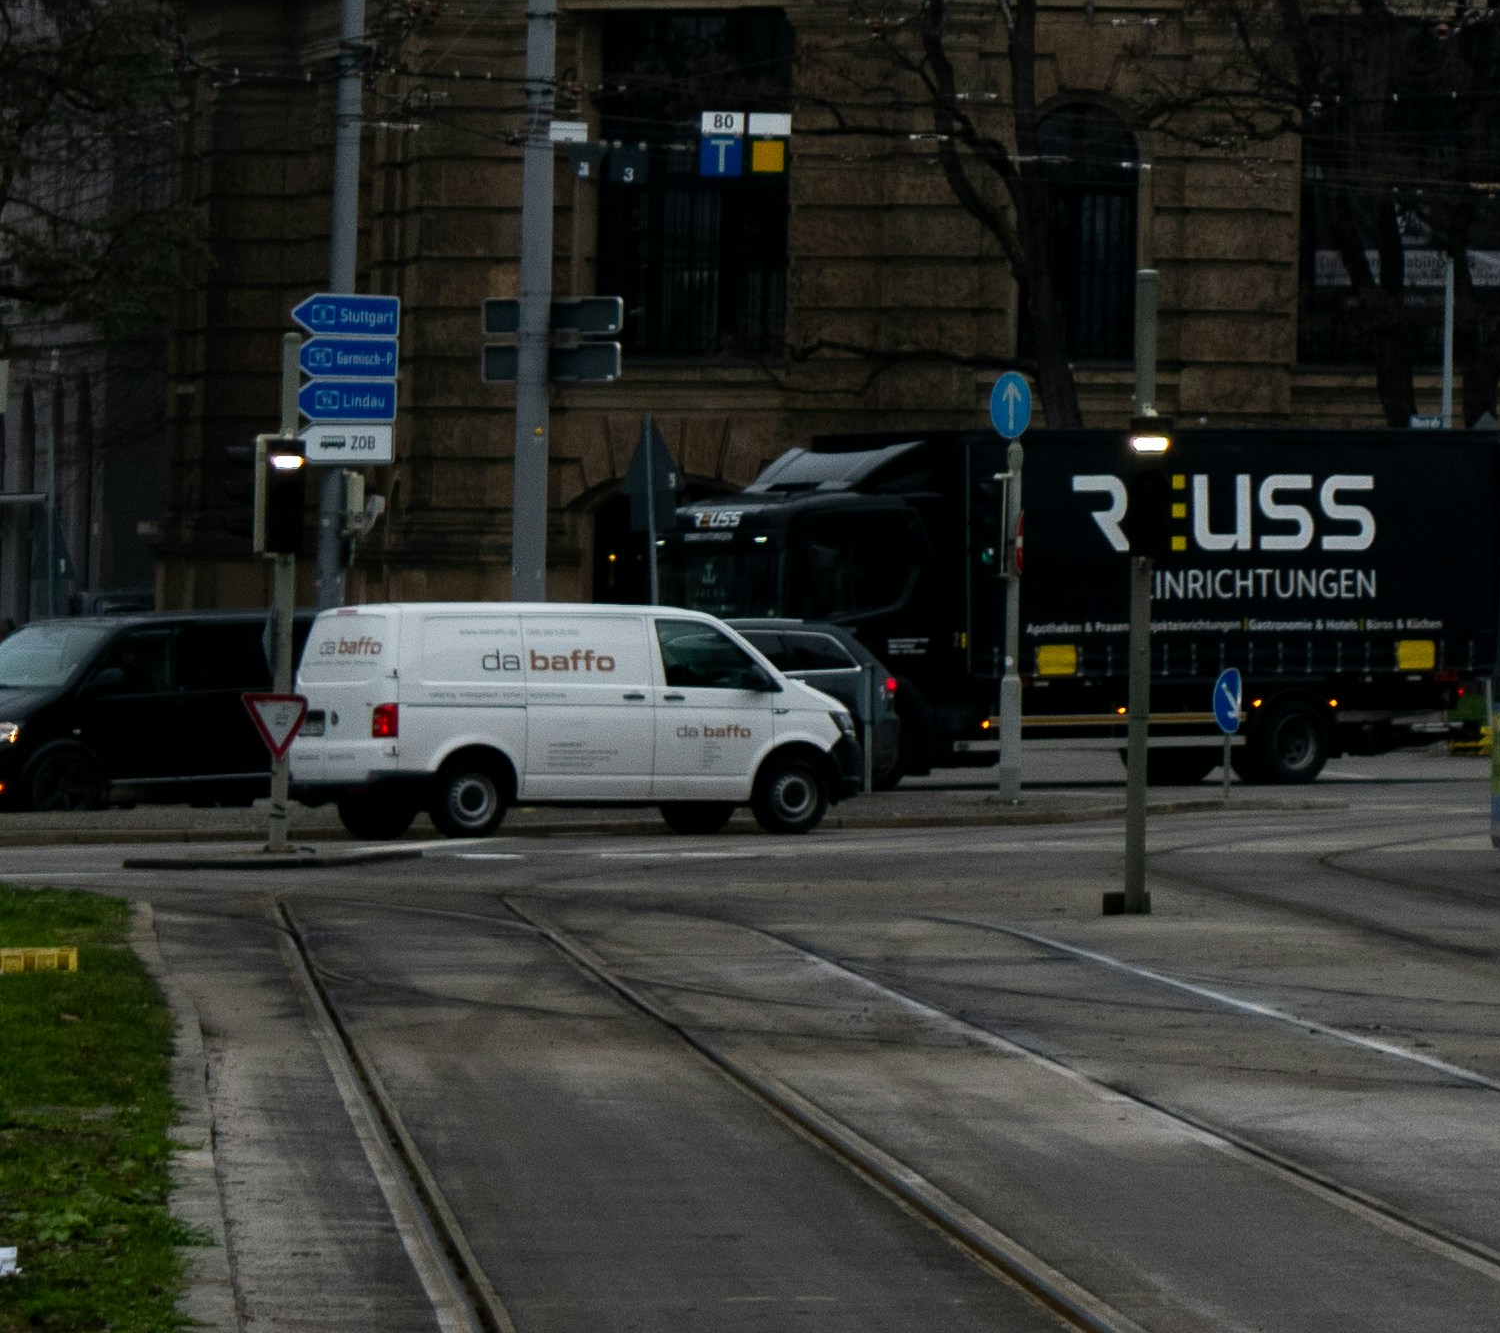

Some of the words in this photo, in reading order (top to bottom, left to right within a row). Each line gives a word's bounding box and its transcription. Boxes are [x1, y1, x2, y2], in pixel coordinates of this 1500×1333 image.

[713, 114, 734, 130] 80
[710, 139, 736, 174] T
[623, 166, 635, 183] 3
[340, 308, 395, 327] Stuttgart
[342, 393, 386, 408] Lindau
[350, 435, 376, 451] ZOB
[1150, 568, 1378, 600] INRICHTUNGEN
[1026, 621, 1082, 637] Apotheken
[1248, 617, 1314, 632] Gastronomie
[1325, 618, 1359, 631] Hotels
[1365, 617, 1396, 631] Büros
[1406, 616, 1445, 631] Küchen
[337, 636, 384, 656] baffo
[481, 648, 521, 672] da
[530, 648, 616, 672] baffo
[676, 724, 700, 739] da
[703, 724, 752, 739] baffo
